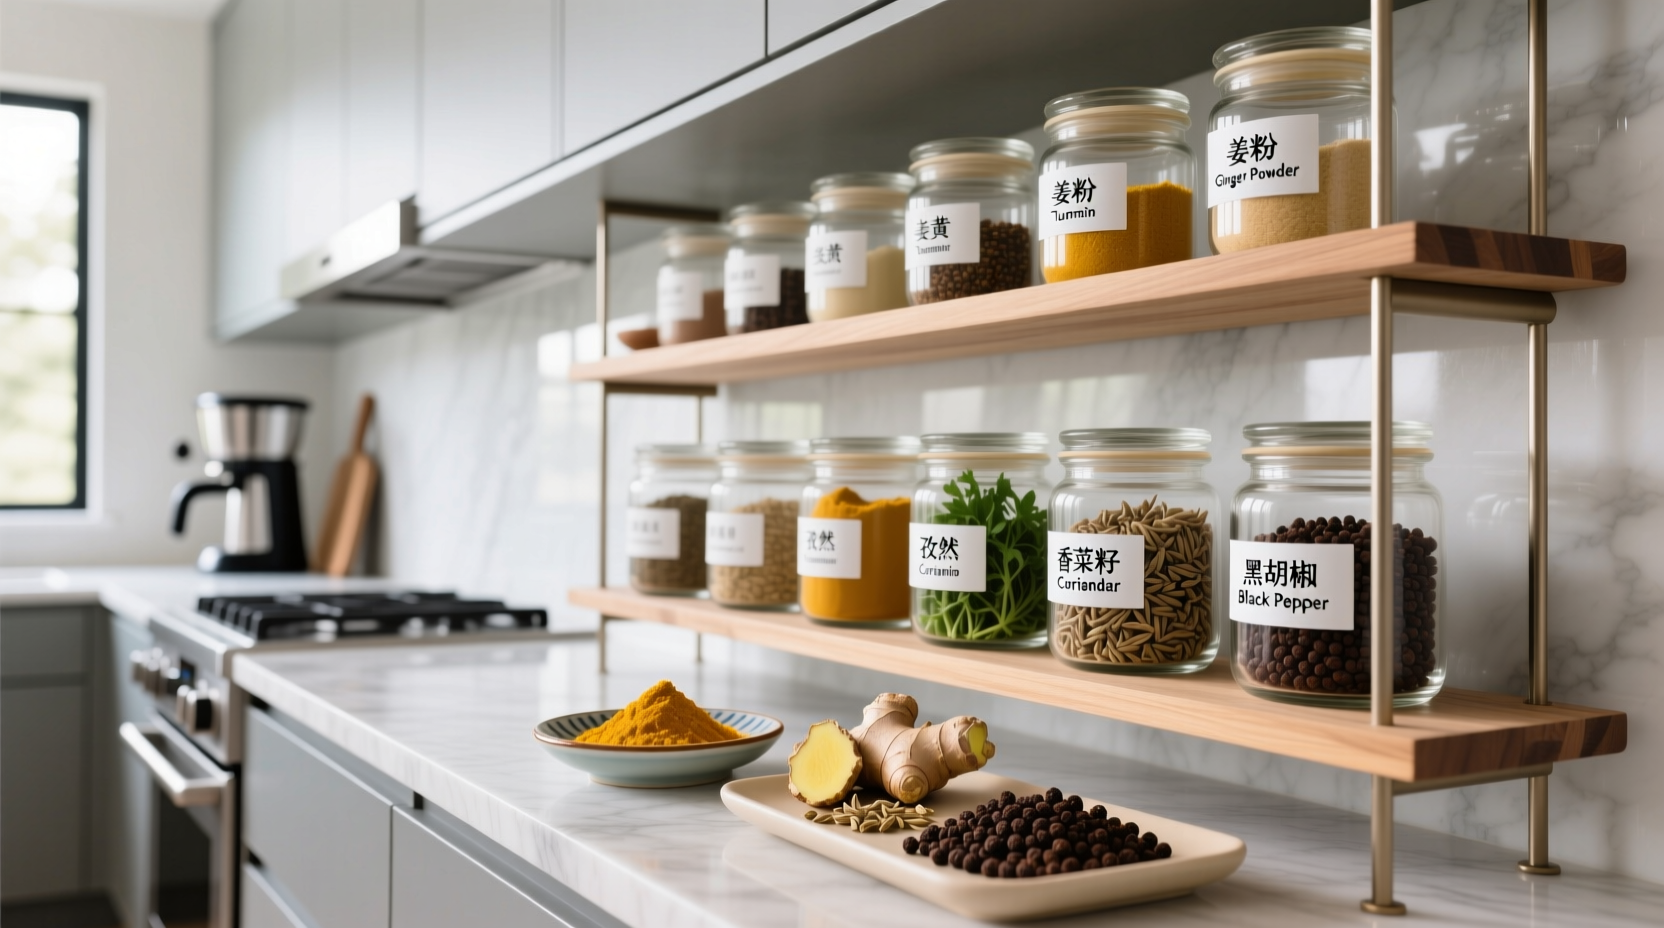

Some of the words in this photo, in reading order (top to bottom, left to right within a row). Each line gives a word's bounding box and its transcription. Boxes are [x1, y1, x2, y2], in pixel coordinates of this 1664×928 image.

[1227, 132, 1278, 167] 姜粉
[1215, 172, 1247, 189] Ginger
[1250, 162, 1300, 181] Powder
[1051, 177, 1097, 206] 姜粉
[920, 536, 960, 561] 孜然
[1057, 546, 1121, 575] 香菜籽
[1243, 558, 1317, 589] 黑胡椒
[1238, 589, 1270, 607] Black
[1274, 592, 1330, 614] Pepper
